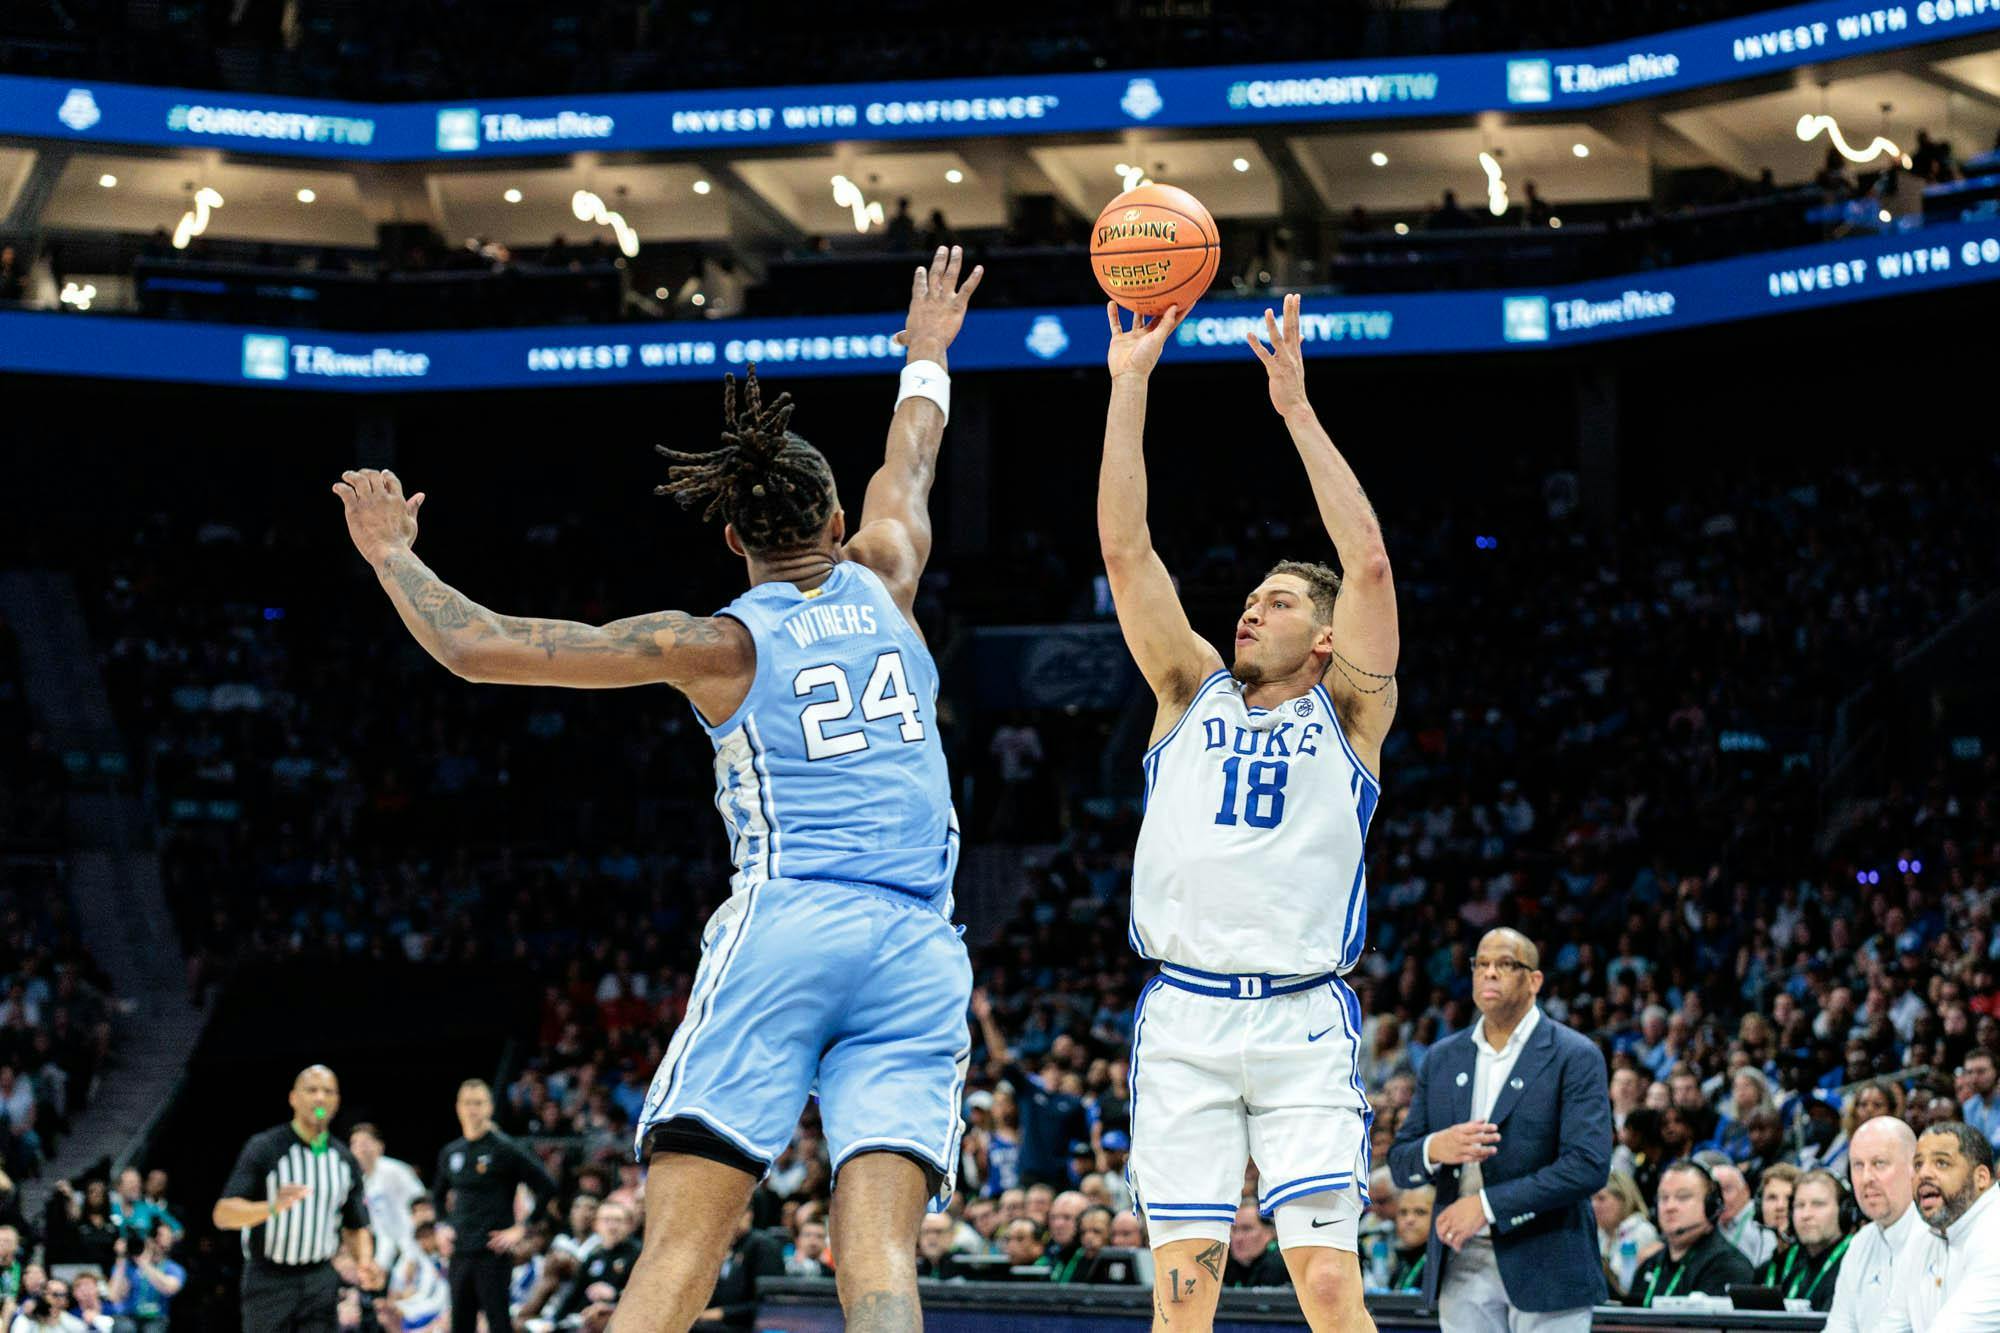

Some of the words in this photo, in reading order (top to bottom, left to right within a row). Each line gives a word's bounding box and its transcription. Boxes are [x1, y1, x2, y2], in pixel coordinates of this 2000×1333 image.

[1733, 22, 1828, 61] INVEST
[1837, 7, 1907, 40] WITH
[672, 108, 774, 133] INVEST
[782, 104, 857, 129] WITH
[1097, 221, 1176, 248] SPALDING
[1103, 260, 1171, 278] LEGACY
[1769, 259, 1867, 297] INVEST
[1877, 246, 1950, 279] WITH
[528, 345, 631, 371] INVEST
[640, 342, 716, 366] WITH
[784, 604, 877, 649] WITHERS
[793, 650, 926, 762] 24
[1203, 717, 1323, 757] DUKE
[1214, 756, 1289, 829] 18
